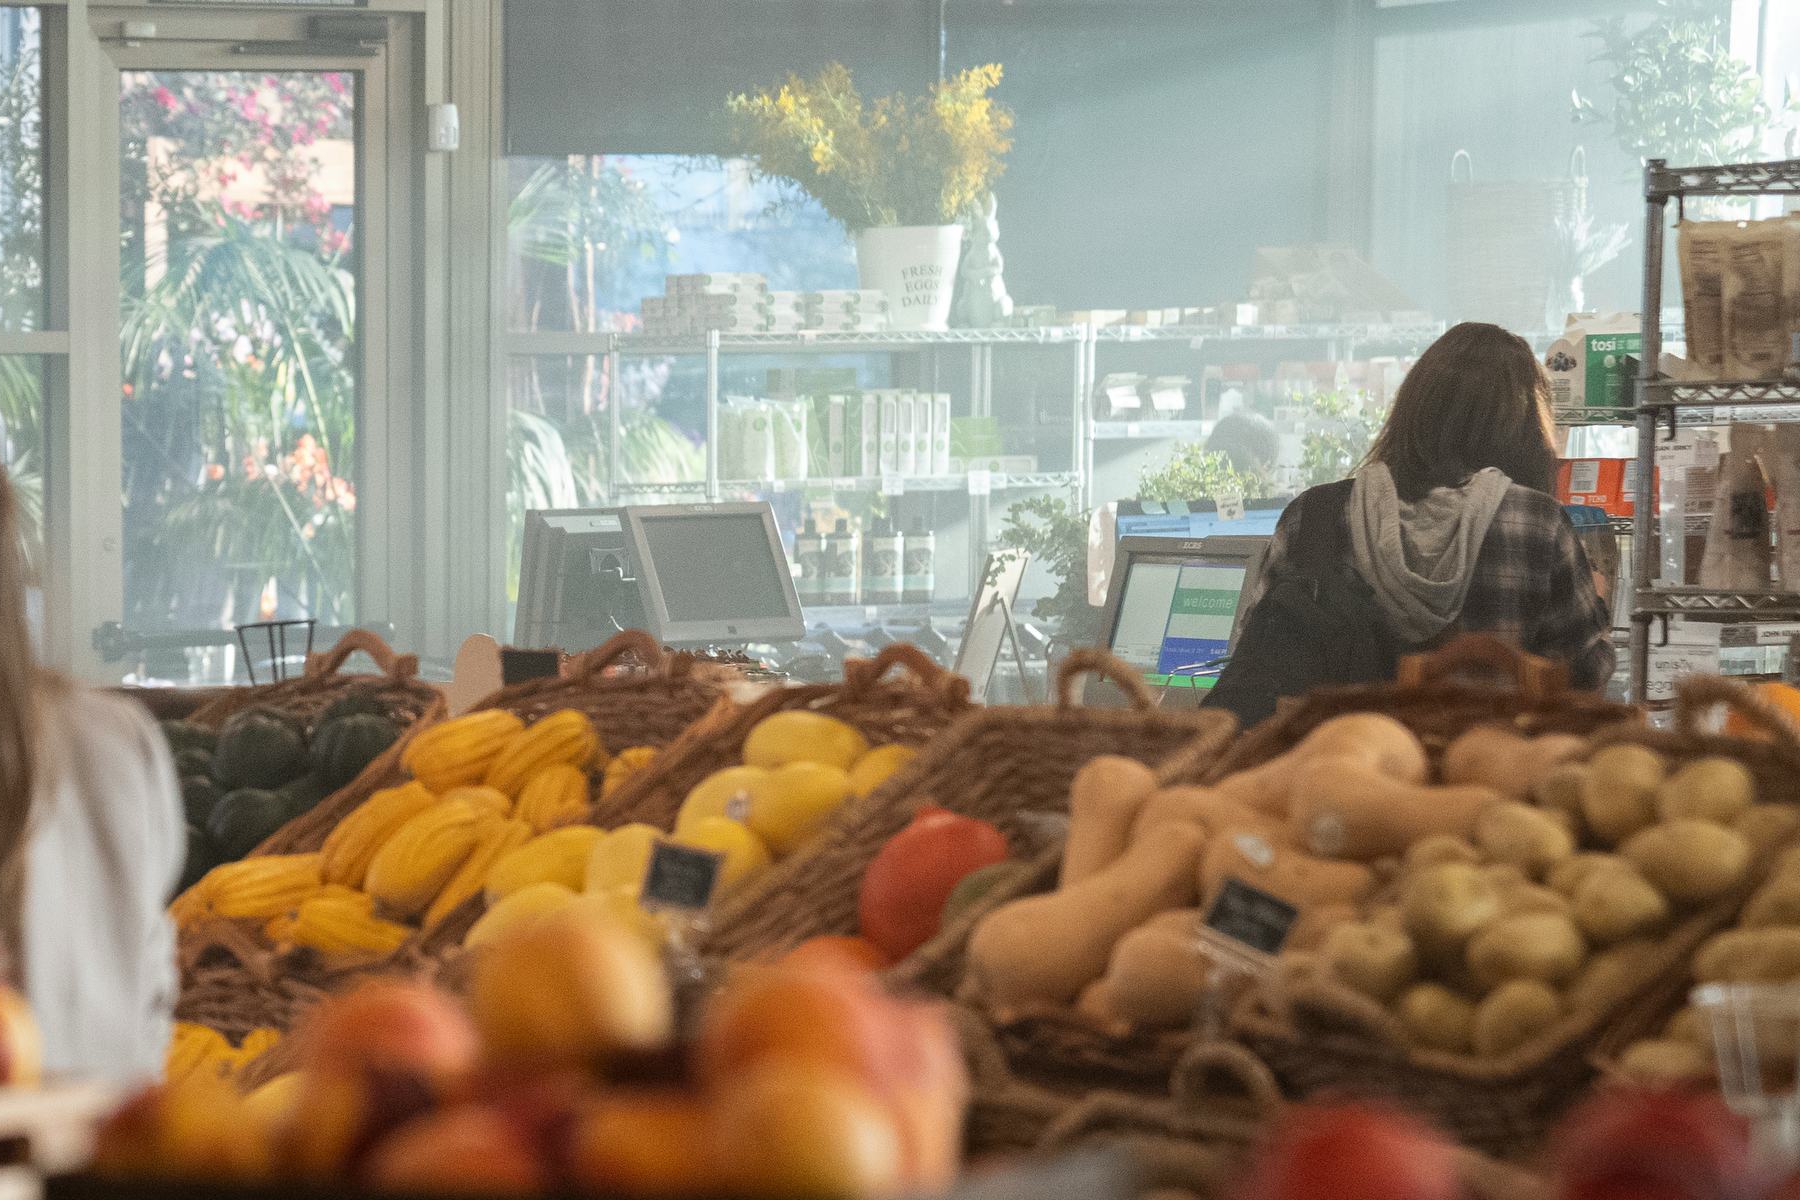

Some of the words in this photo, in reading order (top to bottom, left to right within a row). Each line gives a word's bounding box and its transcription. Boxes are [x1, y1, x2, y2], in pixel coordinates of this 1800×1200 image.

[901, 264, 943, 279] FRESH
[904, 279, 940, 293] EGGS
[901, 294, 938, 307] DAILY
[1183, 596, 1233, 609] welcome
